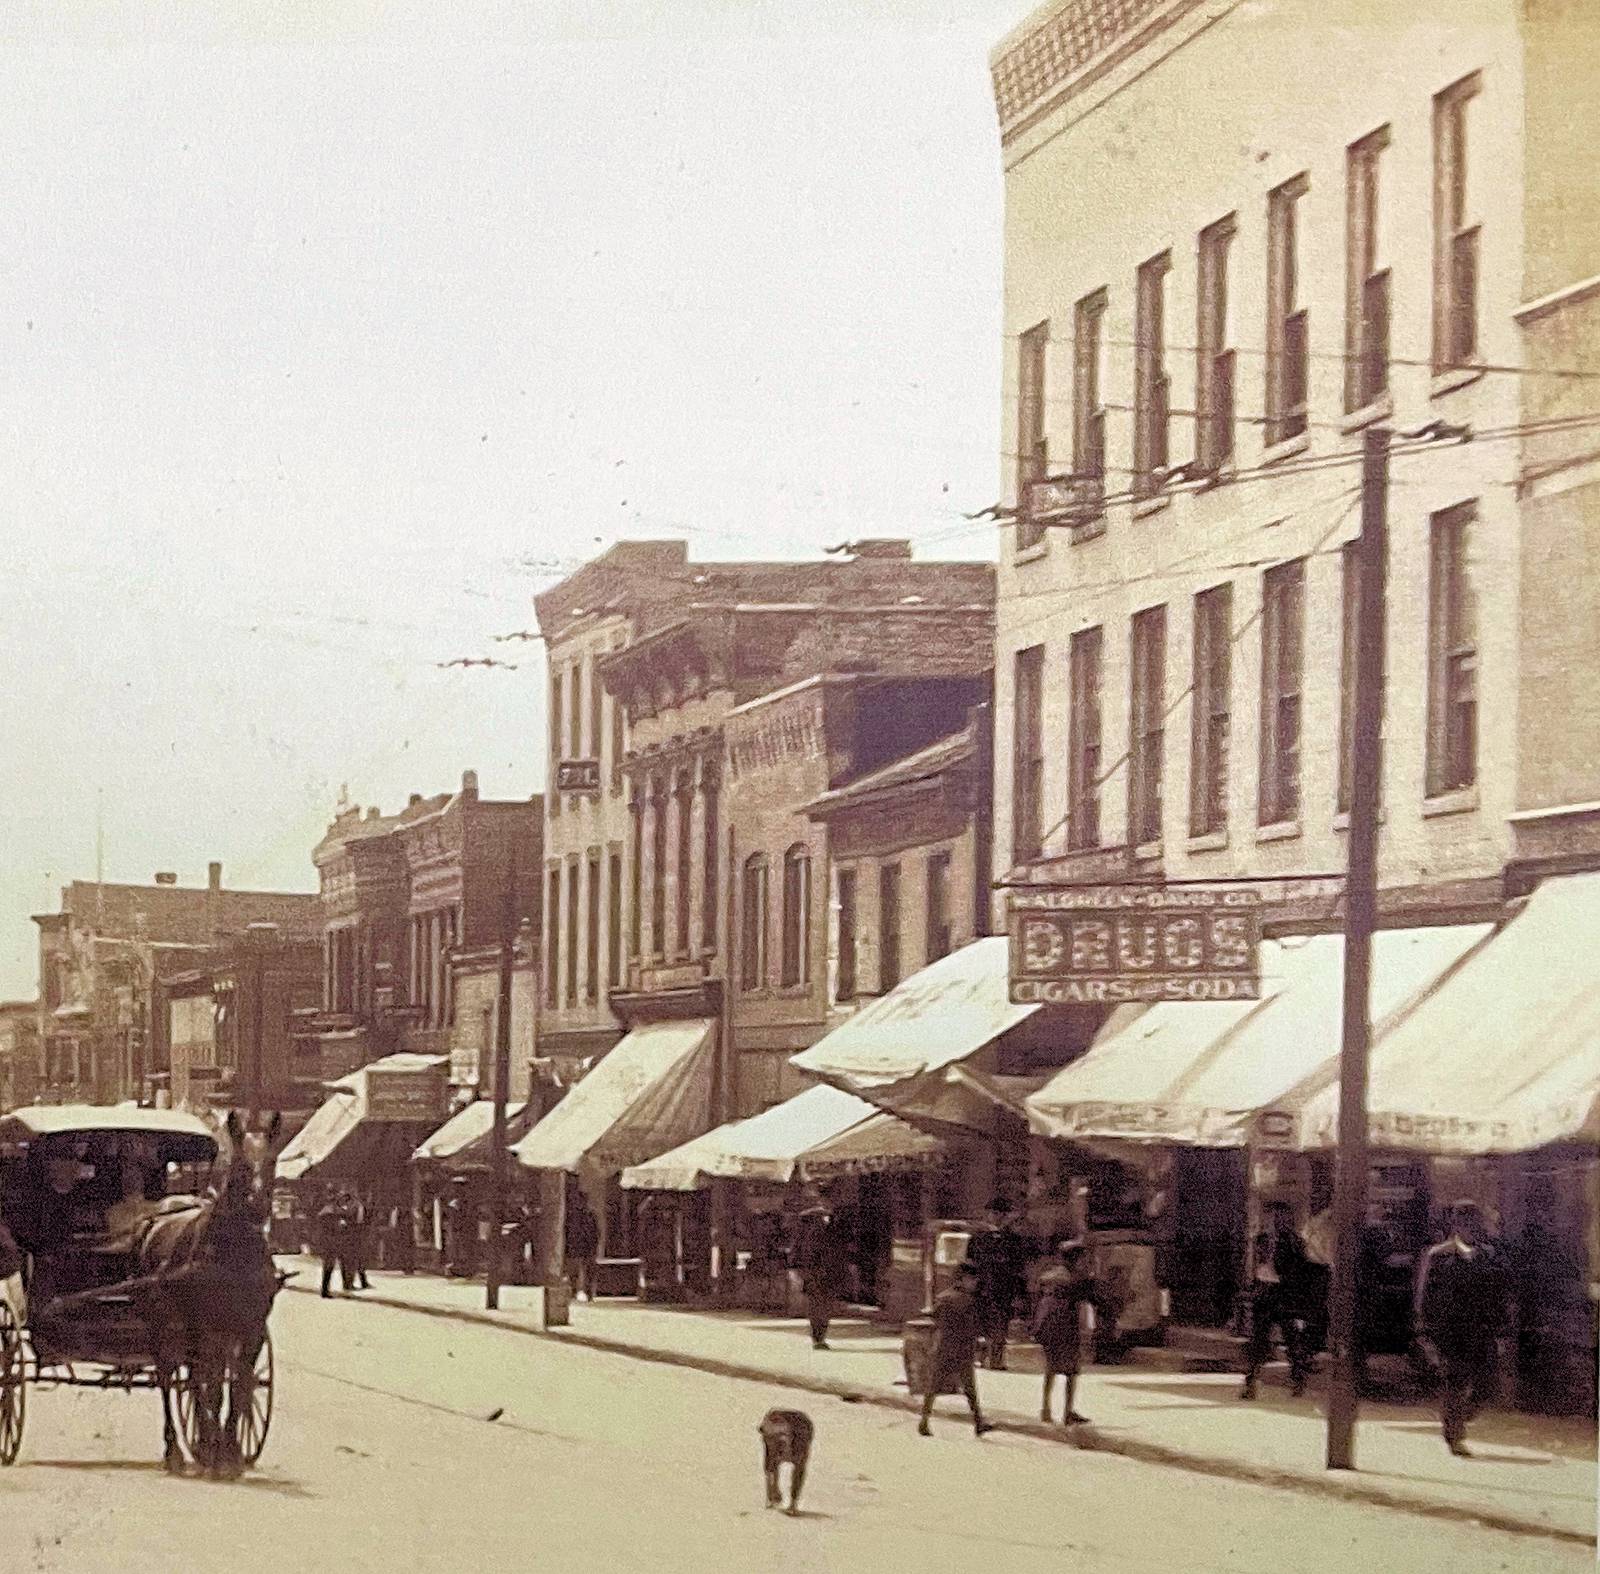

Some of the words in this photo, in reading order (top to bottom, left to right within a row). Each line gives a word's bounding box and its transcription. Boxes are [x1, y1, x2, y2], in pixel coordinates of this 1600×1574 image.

[1025, 917, 1249, 970] DRUGS
[1013, 980, 1132, 1001] CIGARS
[1164, 978, 1257, 999] SODA
